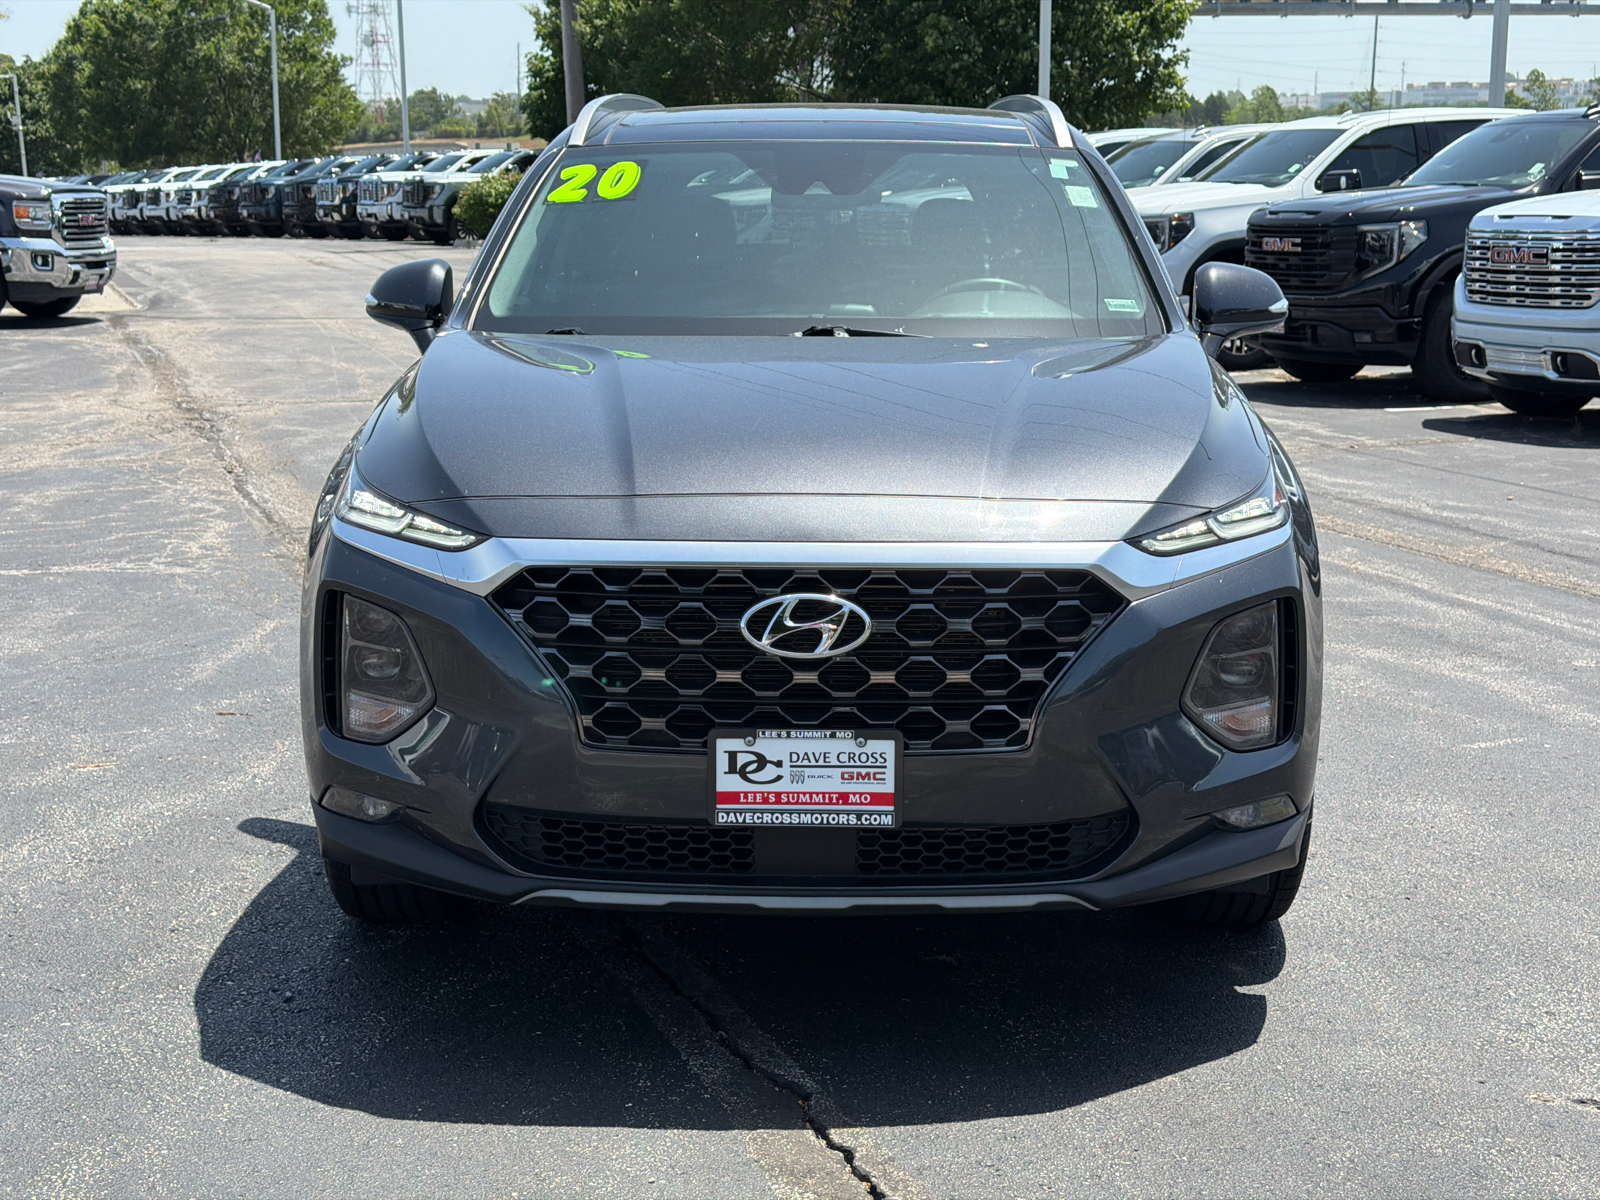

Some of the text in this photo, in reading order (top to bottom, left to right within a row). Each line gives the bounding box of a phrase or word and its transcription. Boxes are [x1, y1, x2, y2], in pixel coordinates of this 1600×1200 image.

[547, 161, 641, 203] 20
[1262, 237, 1301, 252] GMC
[1491, 247, 1547, 264] GMC
[758, 730, 852, 739] LEE'S SUMMIT MO
[789, 751, 887, 764] DAVE CROSS
[840, 771, 886, 782] GMC
[739, 793, 871, 805] LEE'S SUMMIT, MO
[718, 812, 892, 826] DAVECROSSMOTORS.COM
